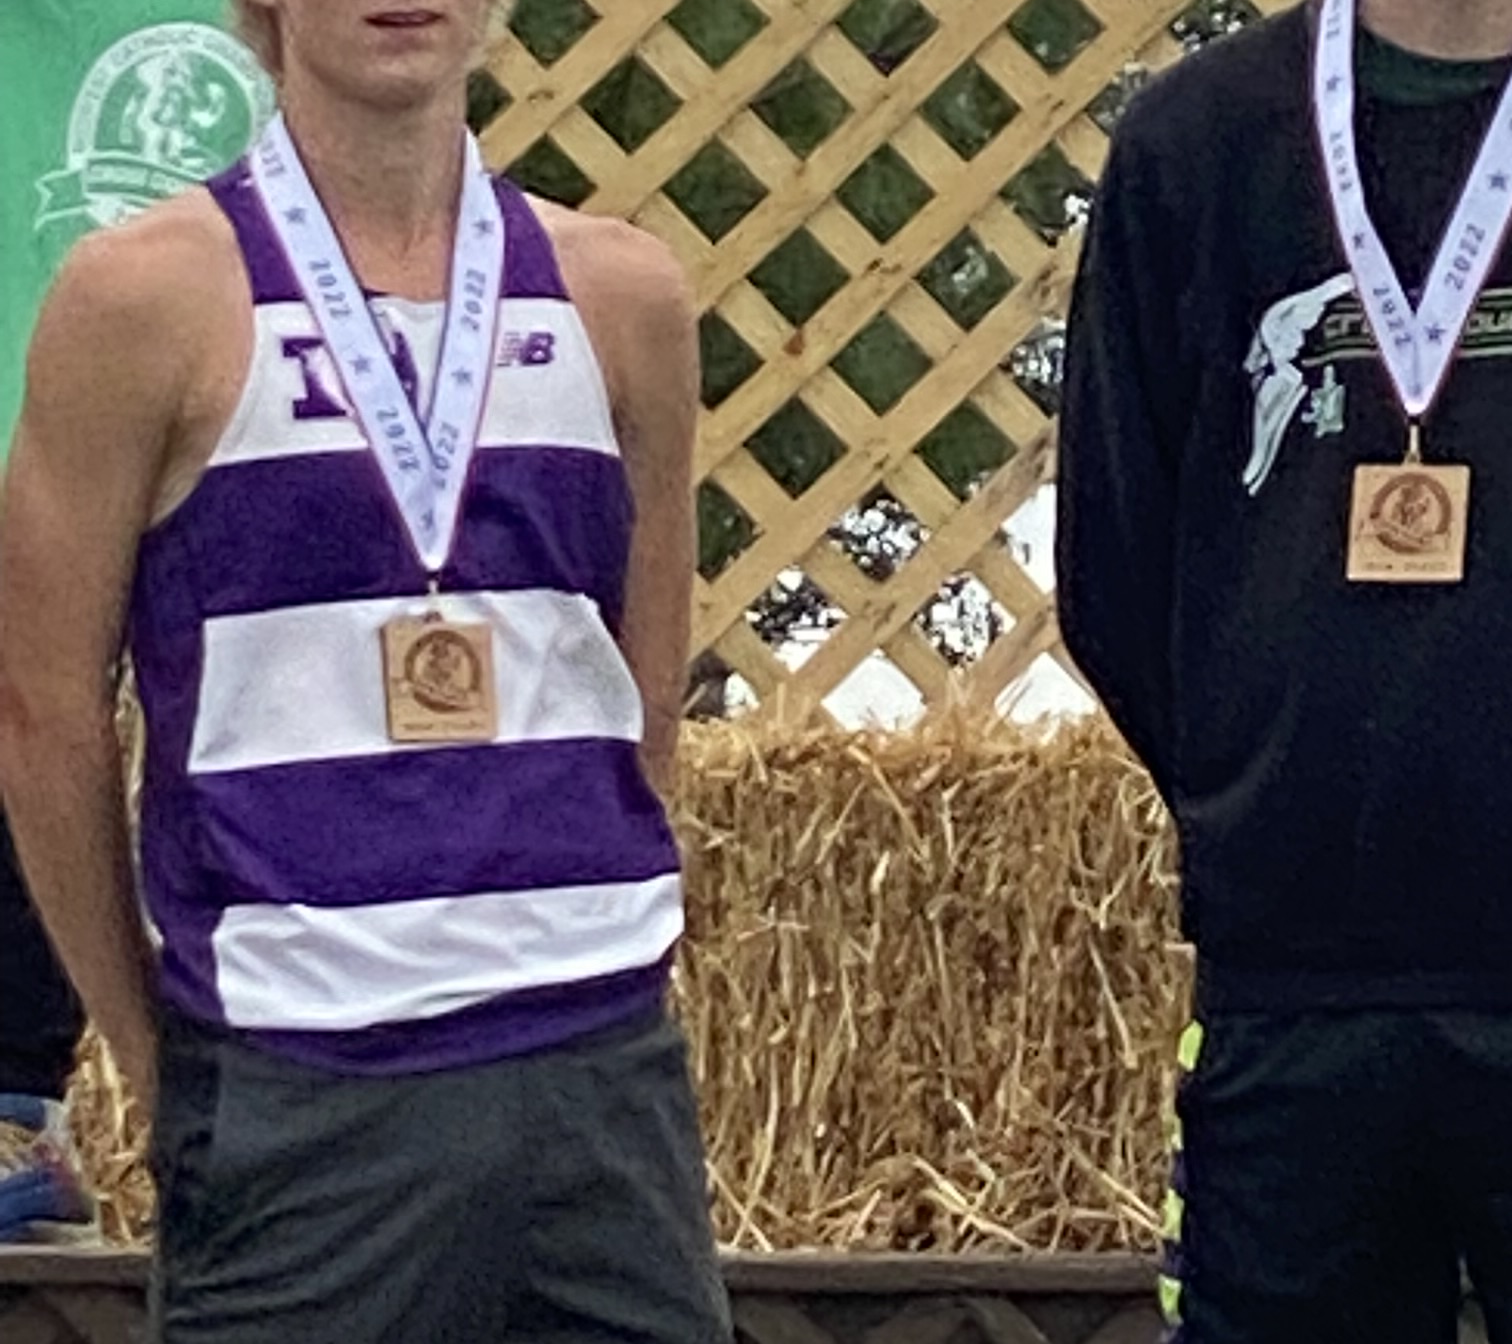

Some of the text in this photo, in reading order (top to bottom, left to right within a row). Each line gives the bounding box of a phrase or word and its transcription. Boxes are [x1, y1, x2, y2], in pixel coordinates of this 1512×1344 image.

[1443, 222, 1486, 292] 2022
[308, 258, 352, 322] 2022
[459, 268, 488, 333] 2022
[375, 407, 421, 473] 2022
